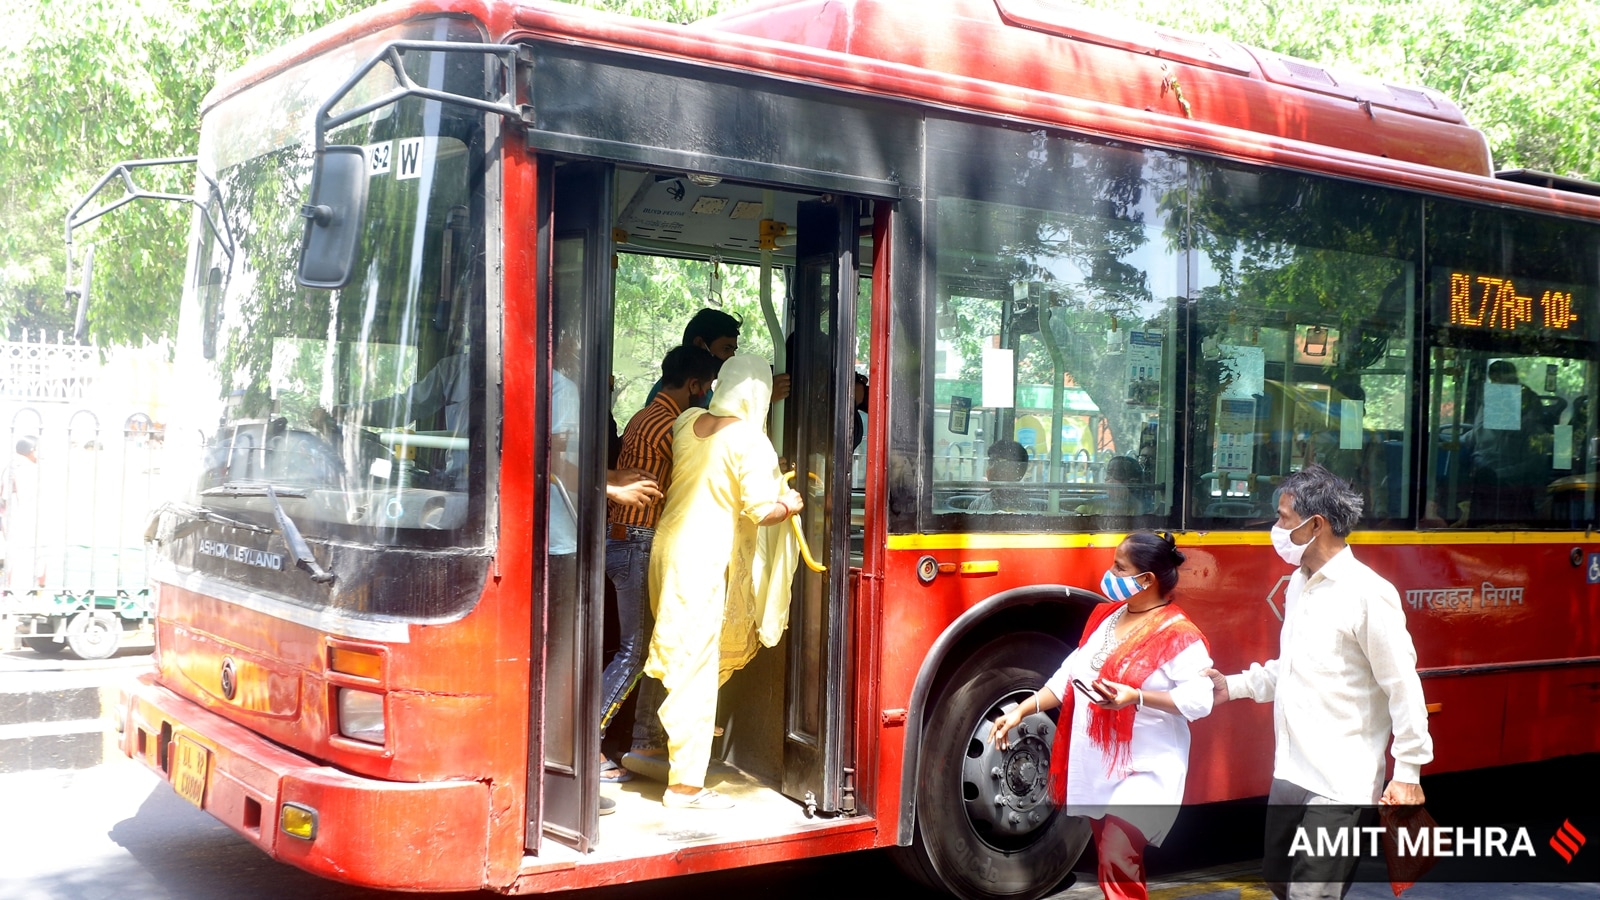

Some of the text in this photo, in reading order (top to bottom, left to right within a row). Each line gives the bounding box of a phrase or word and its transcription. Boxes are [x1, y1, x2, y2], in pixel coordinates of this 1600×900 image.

[401, 142, 419, 175] W
[199, 540, 282, 570] ASHOK LEYLAND
[1481, 581, 1525, 607] निगम
